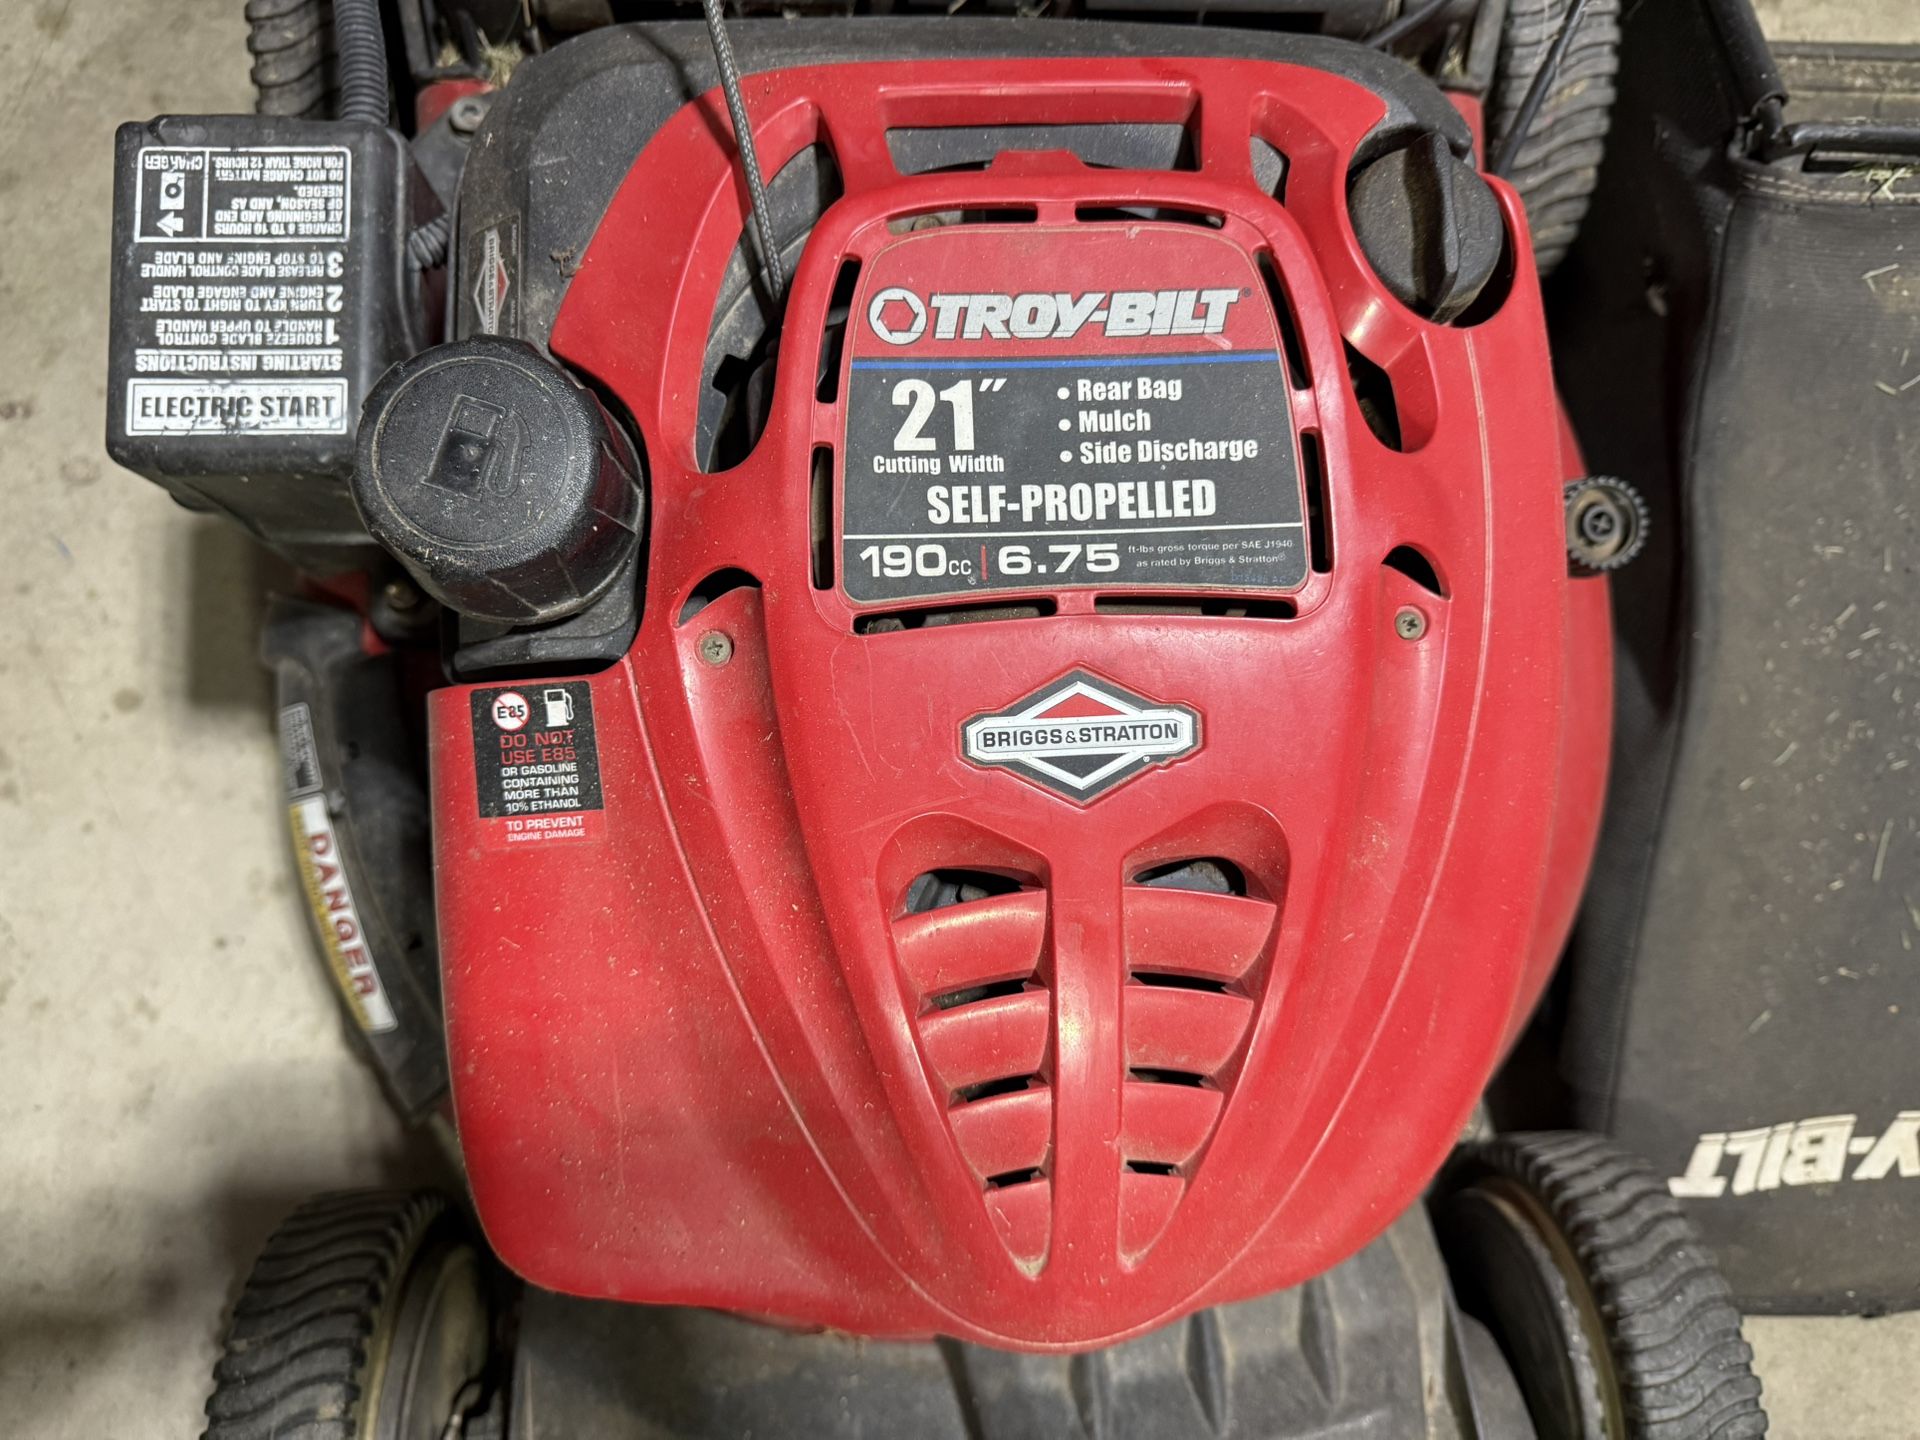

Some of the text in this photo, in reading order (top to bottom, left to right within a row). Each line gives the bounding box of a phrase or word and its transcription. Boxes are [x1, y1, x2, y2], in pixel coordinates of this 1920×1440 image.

[250, 156, 262, 168] 12
[263, 156, 292, 168] THAN
[293, 156, 322, 169] MORE
[324, 156, 344, 169] FOR
[263, 170, 304, 182] CHARGE
[307, 170, 326, 181] NOT
[328, 170, 343, 181] DO
[231, 198, 247, 209] AS
[250, 198, 273, 210] AND
[328, 199, 343, 210] OF
[215, 210, 342, 222] AT BEGINNING AND END
[214, 223, 252, 234] HOURS
[271, 222, 286, 234] TO
[299, 223, 342, 234] CHARGE
[155, 251, 194, 264] BLADE
[198, 252, 223, 264] AND
[274, 252, 305, 264] STOP
[309, 252, 324, 264] TO
[140, 252, 343, 278] 3 RELEASE BLADE CONTROL HANDLE
[140, 285, 343, 312] 2 TURN KEY TO RIGHT TO START
[153, 285, 324, 298] ENGINE AND ENGAGE BLADE
[930, 288, 1240, 341] TROY-BILT
[156, 319, 324, 332] HANDLE TO UPPER HANDLE
[156, 319, 340, 346] 1 SQUEEZE BLADE CONTROL
[136, 354, 343, 372] STARTING INSTRUCTIONS
[1077, 377, 1182, 402] Rear Bag
[140, 396, 335, 418] ELECTRIC START
[1078, 410, 1151, 433] Mulch
[1079, 438, 1258, 465] Side Discharge
[873, 454, 1005, 475] Cutting Width
[927, 479, 1216, 524] SELF-PROPELLED
[1158, 546, 1184, 554] gross
[1188, 544, 1220, 553] torque
[1222, 542, 1238, 552] per
[1242, 540, 1261, 549] SAE
[1264, 540, 1293, 549] J1940
[998, 543, 1120, 575] 6.75
[1136, 560, 1148, 568] as
[1151, 558, 1176, 567] rated
[1180, 558, 1191, 568] by
[1194, 556, 1226, 566] Briggs
[1228, 556, 1236, 564] &
[497, 704, 525, 719] E85
[500, 729, 576, 749] DO NOT
[501, 746, 577, 765] USE E85
[502, 762, 578, 777] OR GASOLINE
[503, 774, 580, 789] CONTAINING
[504, 786, 579, 800] MORE THAN
[505, 798, 582, 812] 10% ETHANOL
[506, 815, 584, 832] TO PREVENT
[507, 828, 586, 842] ENGINE DAMAGE
[307, 833, 378, 998] DANGER
